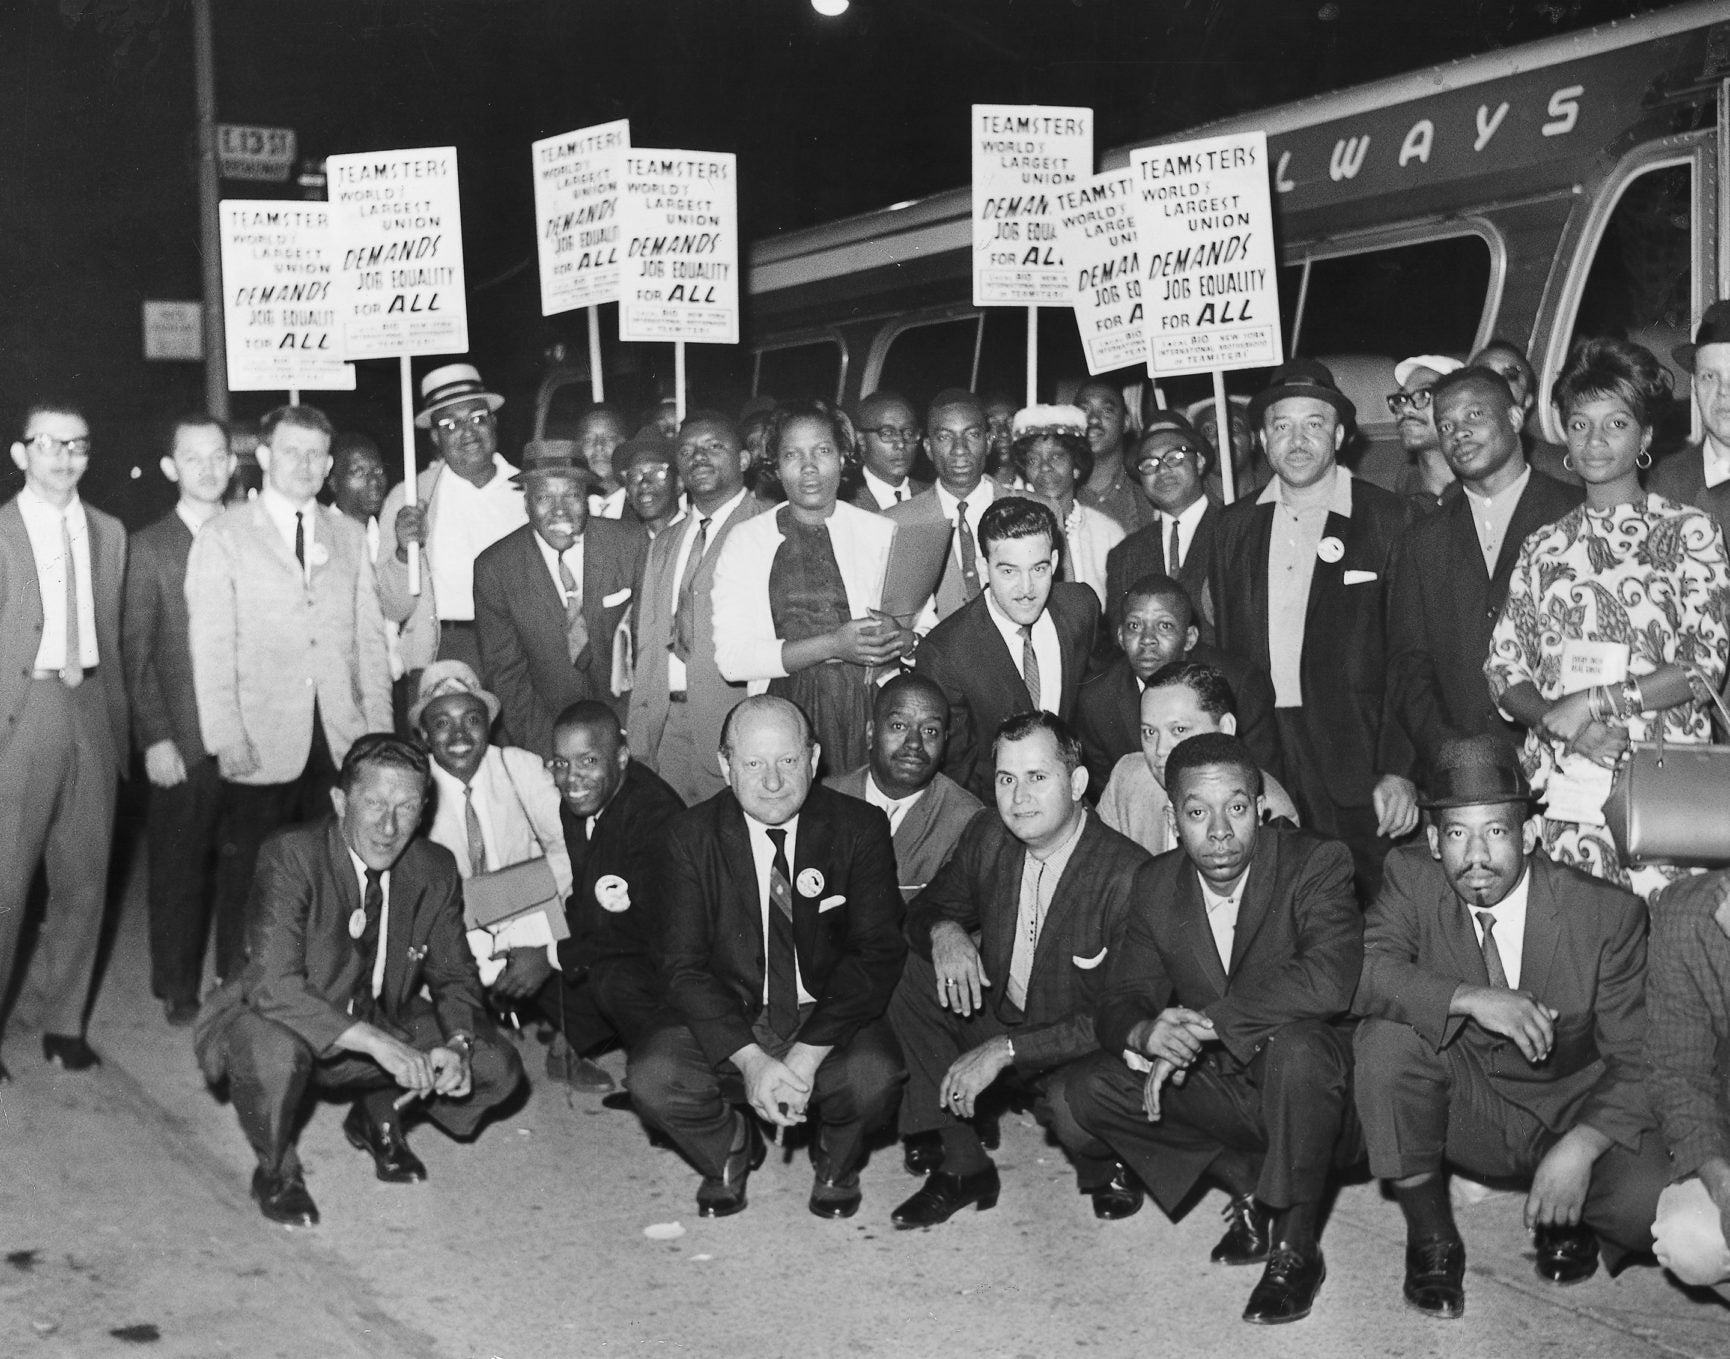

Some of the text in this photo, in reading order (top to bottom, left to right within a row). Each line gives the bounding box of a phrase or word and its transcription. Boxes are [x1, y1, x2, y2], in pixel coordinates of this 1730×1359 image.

[982, 116, 1085, 135] TEAMSTERS
[541, 131, 622, 163] TEAMSTERS
[338, 160, 447, 183] TEAMSTERS
[627, 159, 727, 179] TEAMSTERS
[1001, 157, 1068, 170] LARGEST
[1141, 146, 1255, 180] TEAMSTERS
[557, 168, 610, 191] LARGEST
[1022, 173, 1075, 185] UNION
[574, 181, 617, 200] UNION
[1057, 178, 1133, 211] TEAMST
[360, 201, 431, 218] LARGEST
[646, 198, 712, 211] LARGEST
[982, 194, 1051, 220] DEMAN
[1164, 195, 1240, 217] LARGEST
[382, 217, 441, 231] UNION
[545, 196, 618, 240] DEMANDS
[667, 214, 719, 226] UNION
[1189, 213, 1250, 232] UNION
[994, 222, 1020, 240] JOB
[343, 234, 442, 271] DEMANDS
[555, 234, 573, 256] JOB
[628, 233, 720, 258] DEMANDS
[577, 248, 618, 272] ALL
[991, 253, 1016, 265] FOR
[1149, 233, 1252, 280] DEMANDS
[274, 264, 331, 275] UNION
[357, 266, 455, 290] JOB EQUALITY
[640, 260, 730, 282] JOB EQUALITY
[235, 281, 331, 307] DEMANDS
[637, 289, 661, 301] FOR
[668, 284, 716, 303] ALL
[1163, 277, 1190, 301] JOB
[1200, 268, 1266, 297] EQUALITY
[354, 293, 440, 316] FOR ALL
[1095, 286, 1120, 307] JOB
[249, 310, 274, 327] JOB
[1096, 315, 1122, 332] FOR
[1162, 313, 1190, 330] FOR
[1196, 299, 1253, 326] ALL
[278, 332, 330, 350] ALL
